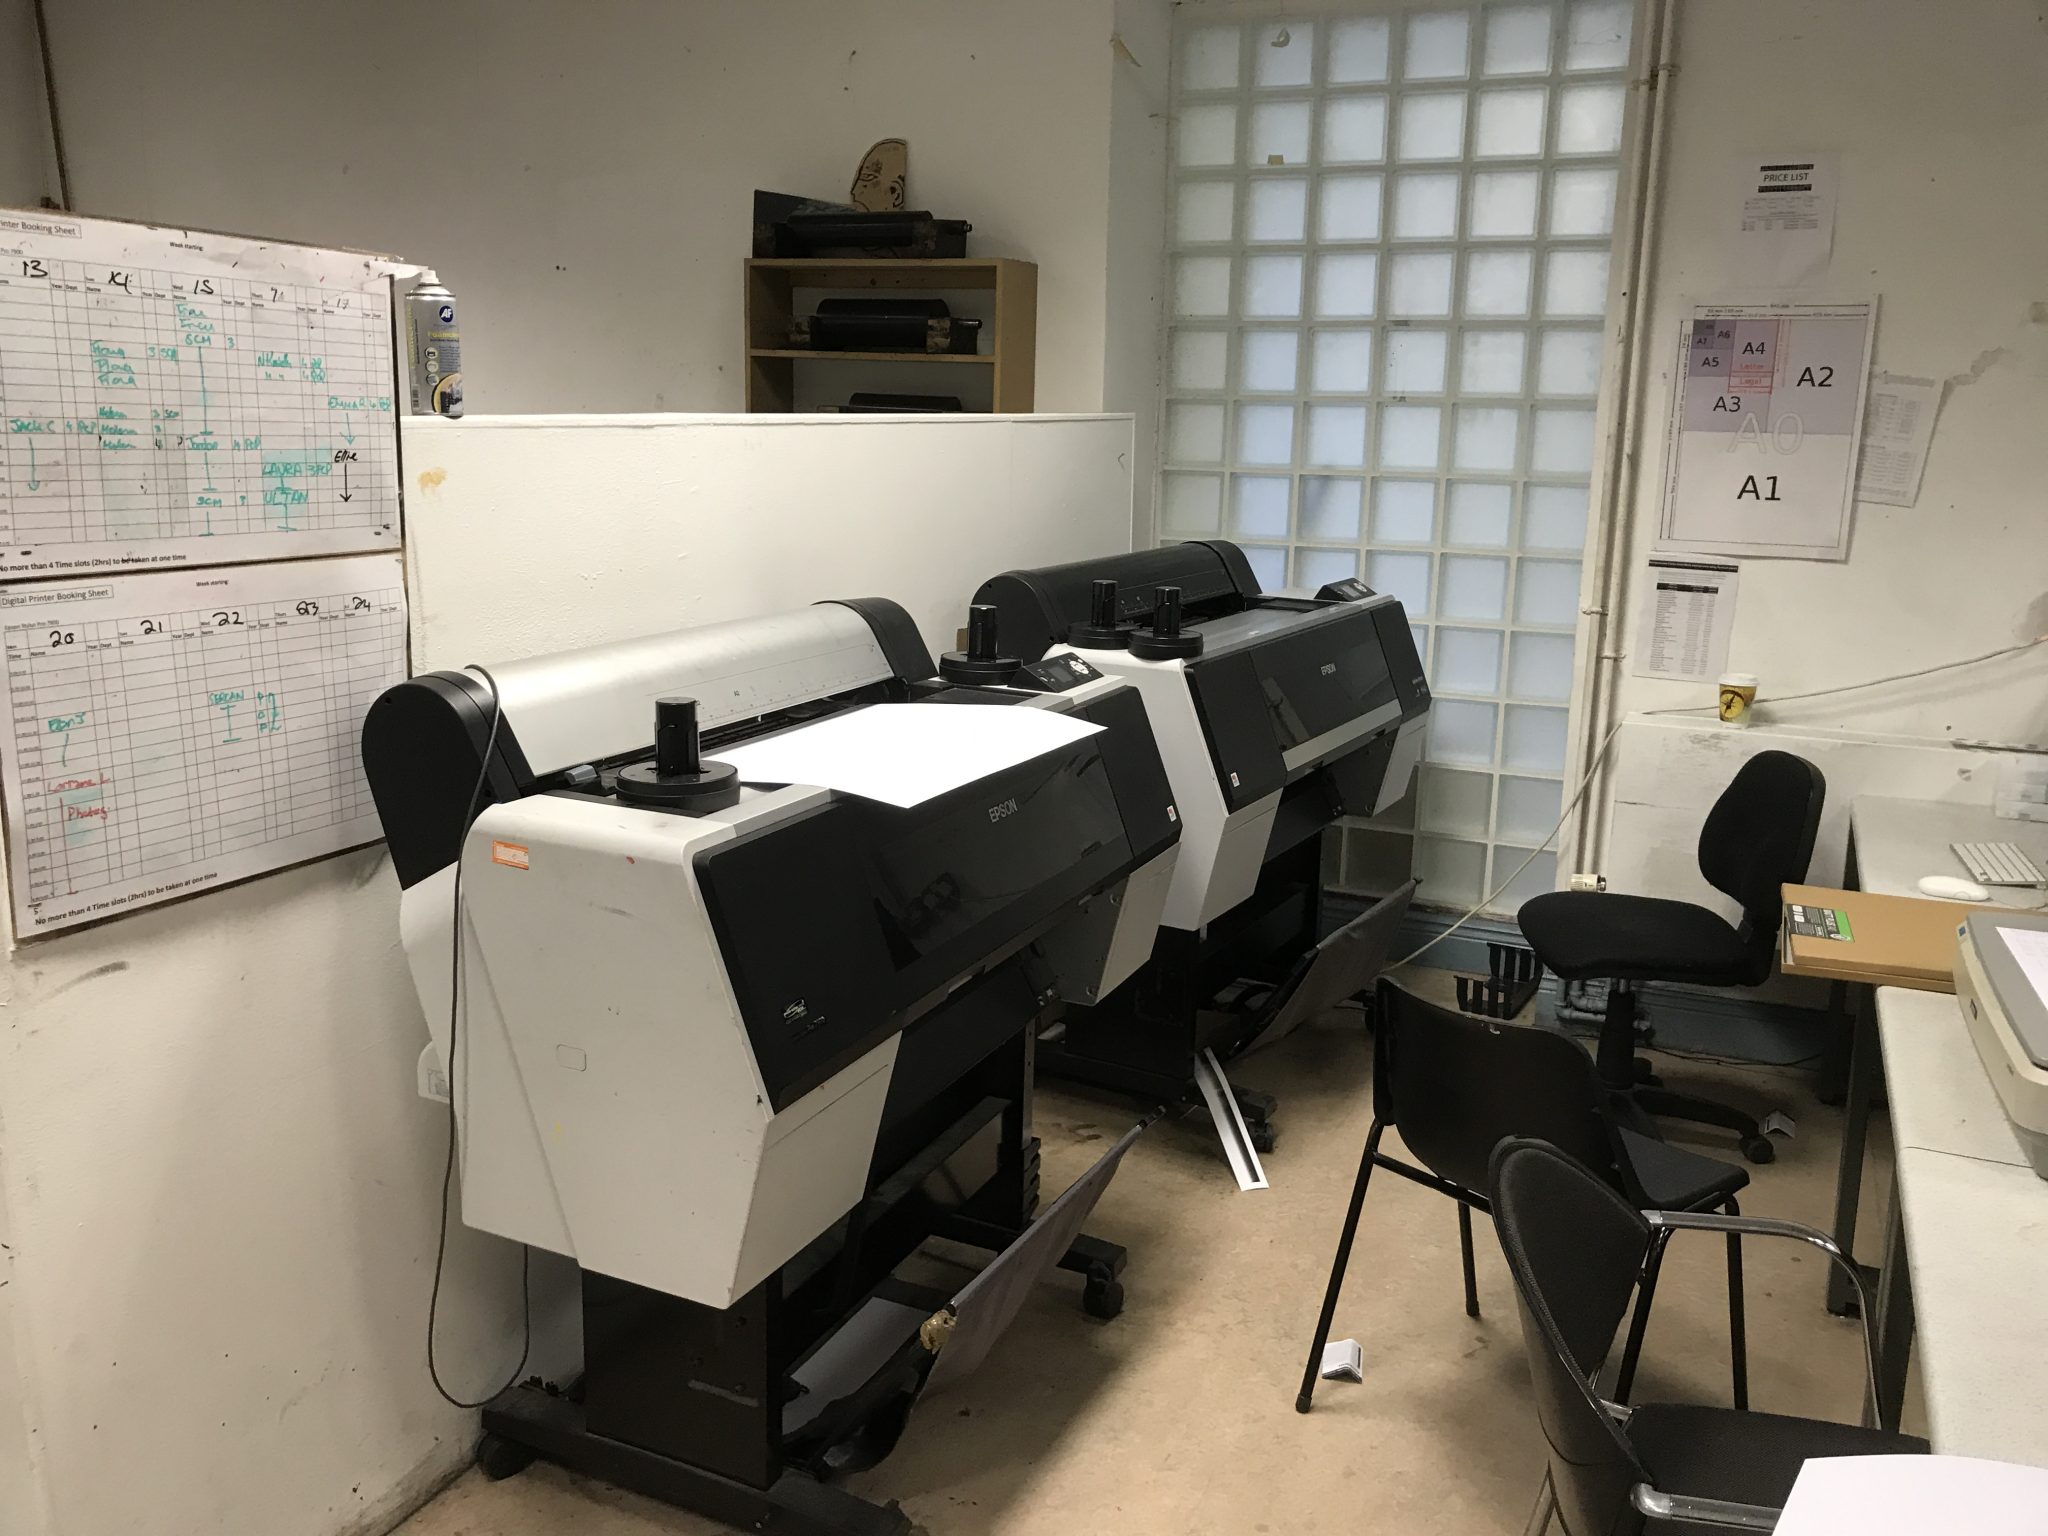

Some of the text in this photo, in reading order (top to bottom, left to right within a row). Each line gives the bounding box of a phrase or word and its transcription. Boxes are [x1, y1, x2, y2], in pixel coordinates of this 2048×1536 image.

[1763, 173, 1809, 182] PRICE LIST
[21, 222, 52, 235] Booking
[55, 226, 76, 235] Sheet
[22, 260, 48, 277] 13
[440, 308, 452, 318] AF
[1717, 330, 1731, 339] A6
[1742, 342, 1766, 355] A4
[1701, 357, 1719, 367] A5
[1796, 366, 1834, 387] A2
[1713, 396, 1741, 412] A3
[1727, 411, 1805, 455] A0
[1737, 475, 1781, 501] A1
[30, 562, 47, 570] than
[92, 558, 111, 567] (2hrs)
[2, 588, 109, 607] Digital Printer Booking Sheet
[352, 596, 371, 612] 24
[212, 611, 244, 626] 22
[140, 620, 162, 635] 21
[989, 798, 1017, 823] EPSON
[35, 918, 46, 926] No
[47, 913, 66, 923] more
[68, 908, 85, 918] than
[86, 904, 91, 912] 4
[92, 901, 110, 911] Time
[111, 897, 127, 907] slots
[128, 891, 147, 902] (2hrs)
[156, 886, 164, 894] be
[165, 882, 183, 891] taken
[192, 876, 203, 884] one
[204, 872, 218, 881] time
